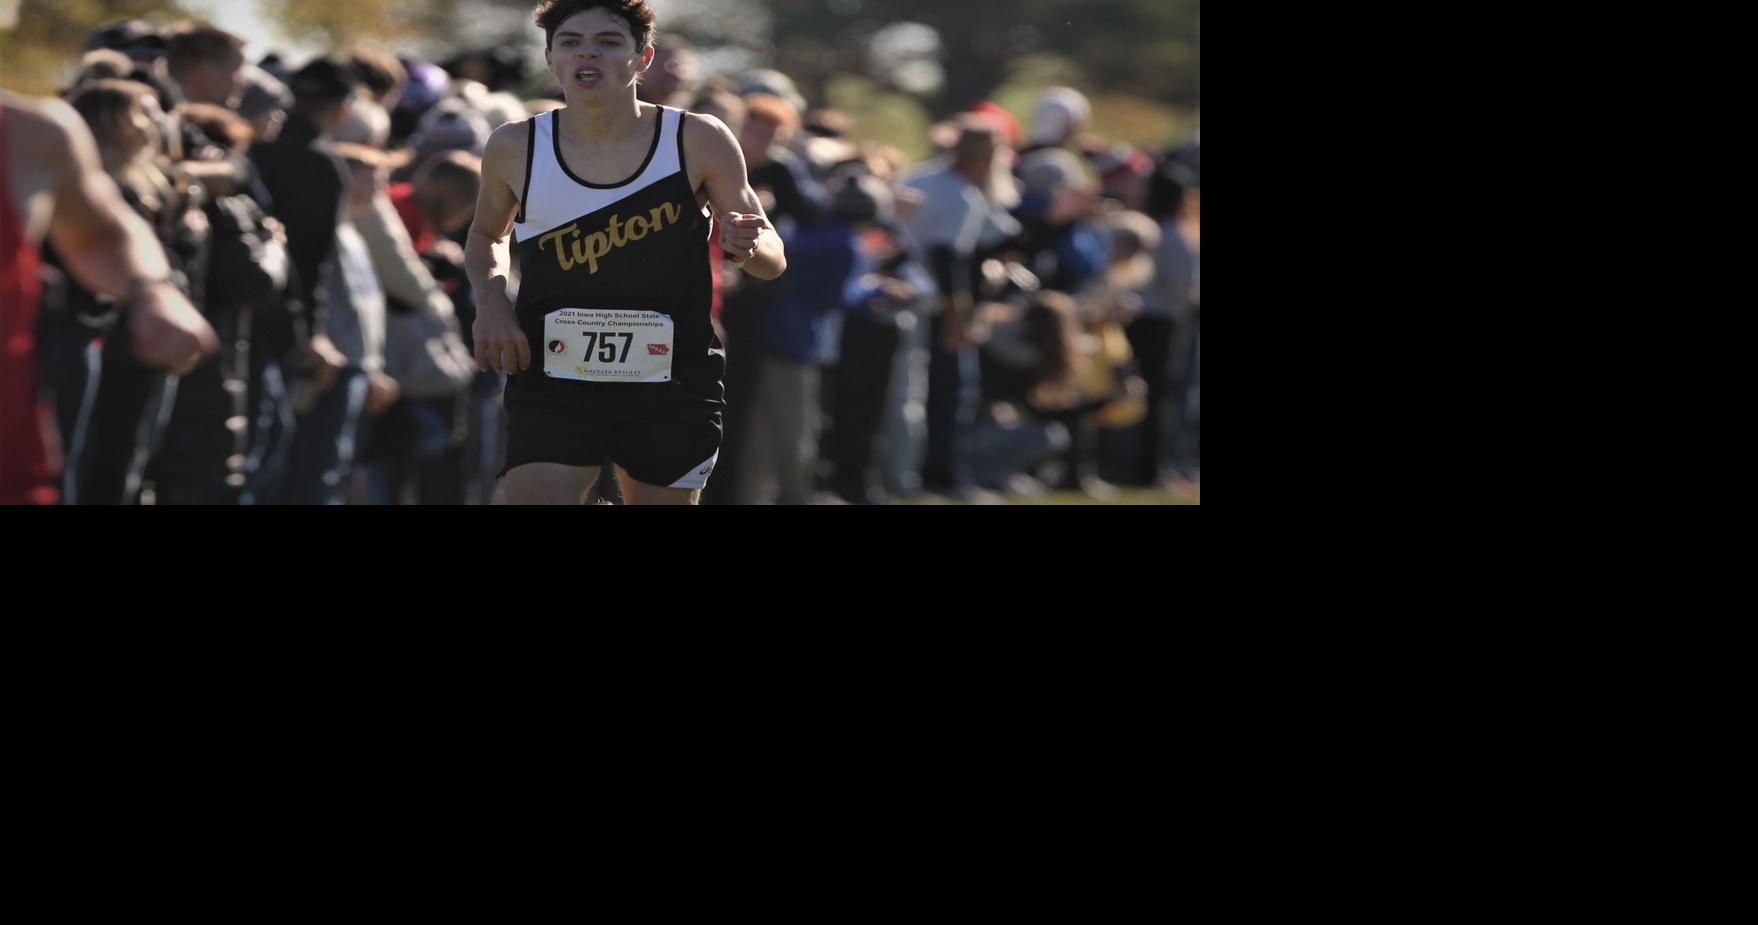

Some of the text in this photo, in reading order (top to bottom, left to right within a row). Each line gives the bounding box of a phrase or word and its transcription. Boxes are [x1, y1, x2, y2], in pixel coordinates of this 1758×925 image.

[538, 201, 680, 275] Tipton
[577, 319, 606, 327] Country
[582, 331, 633, 363] 757
